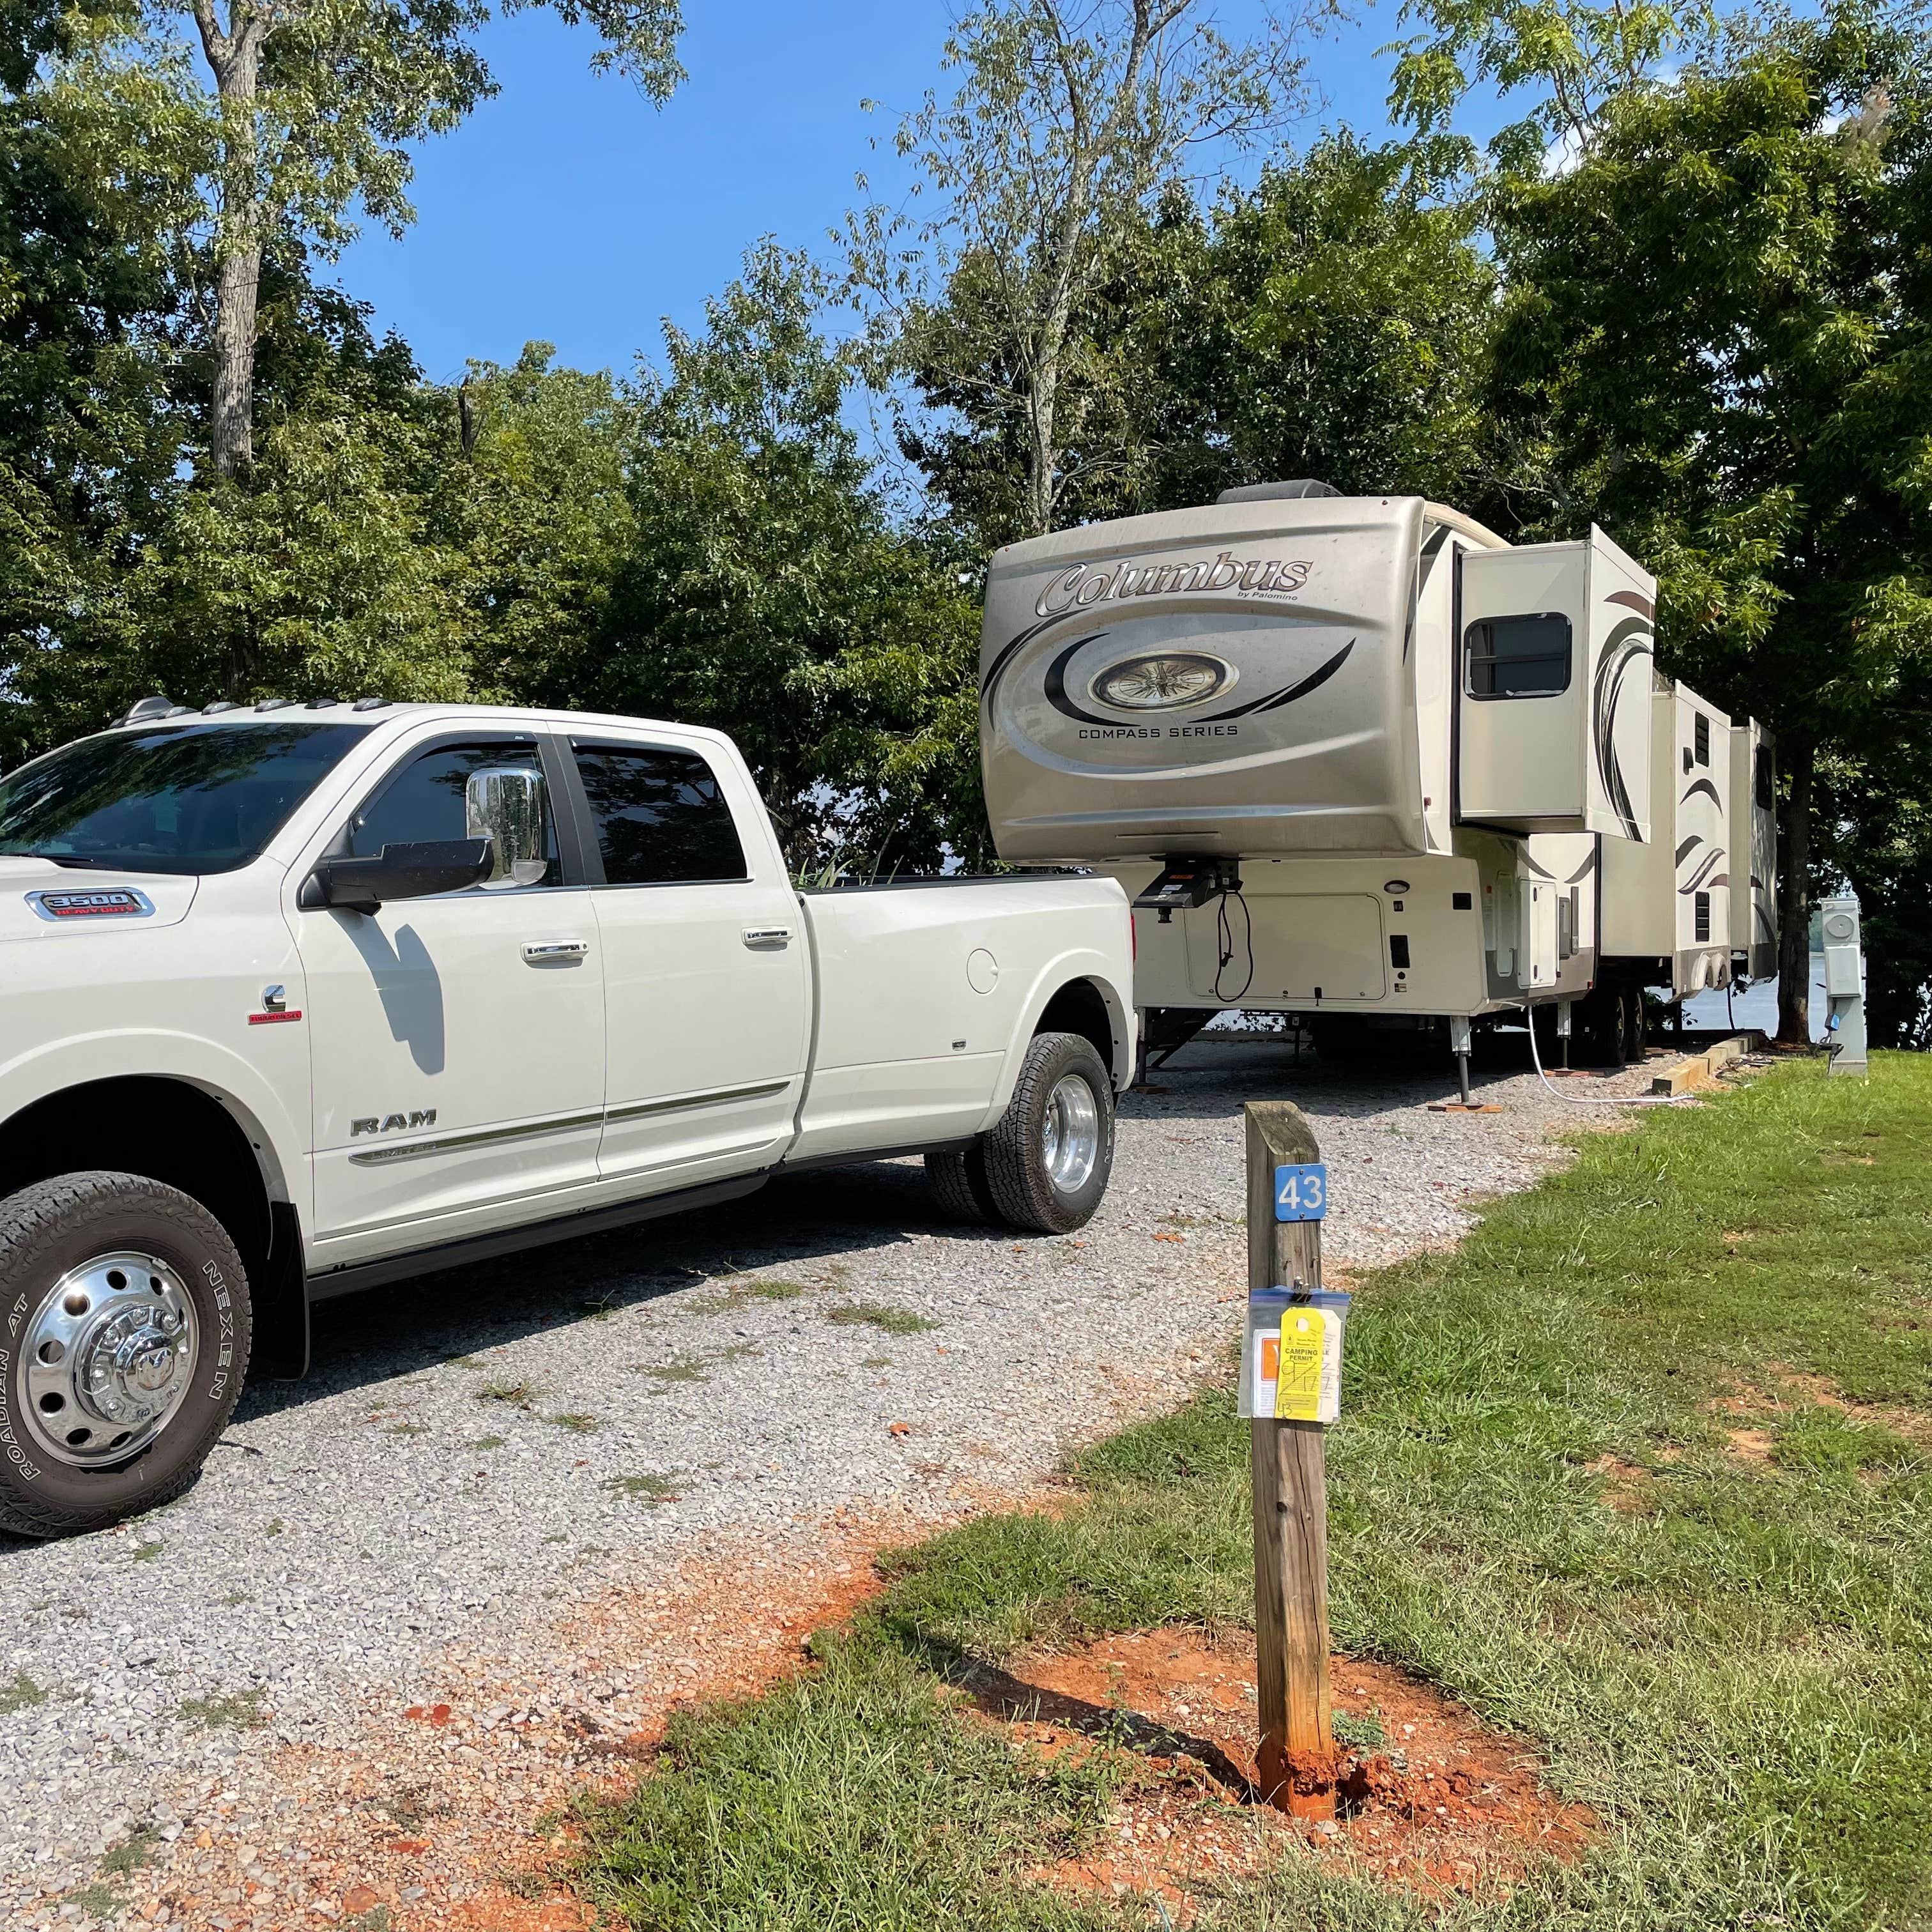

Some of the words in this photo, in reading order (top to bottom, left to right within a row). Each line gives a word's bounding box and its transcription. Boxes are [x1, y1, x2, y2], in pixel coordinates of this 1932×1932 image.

[1035, 551, 1314, 617] Columbus
[1252, 592, 1298, 601] Palomino
[1078, 728, 1160, 739] COMPASS
[1169, 726, 1238, 737] SERIES
[49, 894, 128, 908] 3500
[351, 1108, 437, 1137] RAM
[1278, 1176, 1322, 1209] 43
[8, 1292, 28, 1338] AT
[202, 1259, 234, 1400] NEXEN
